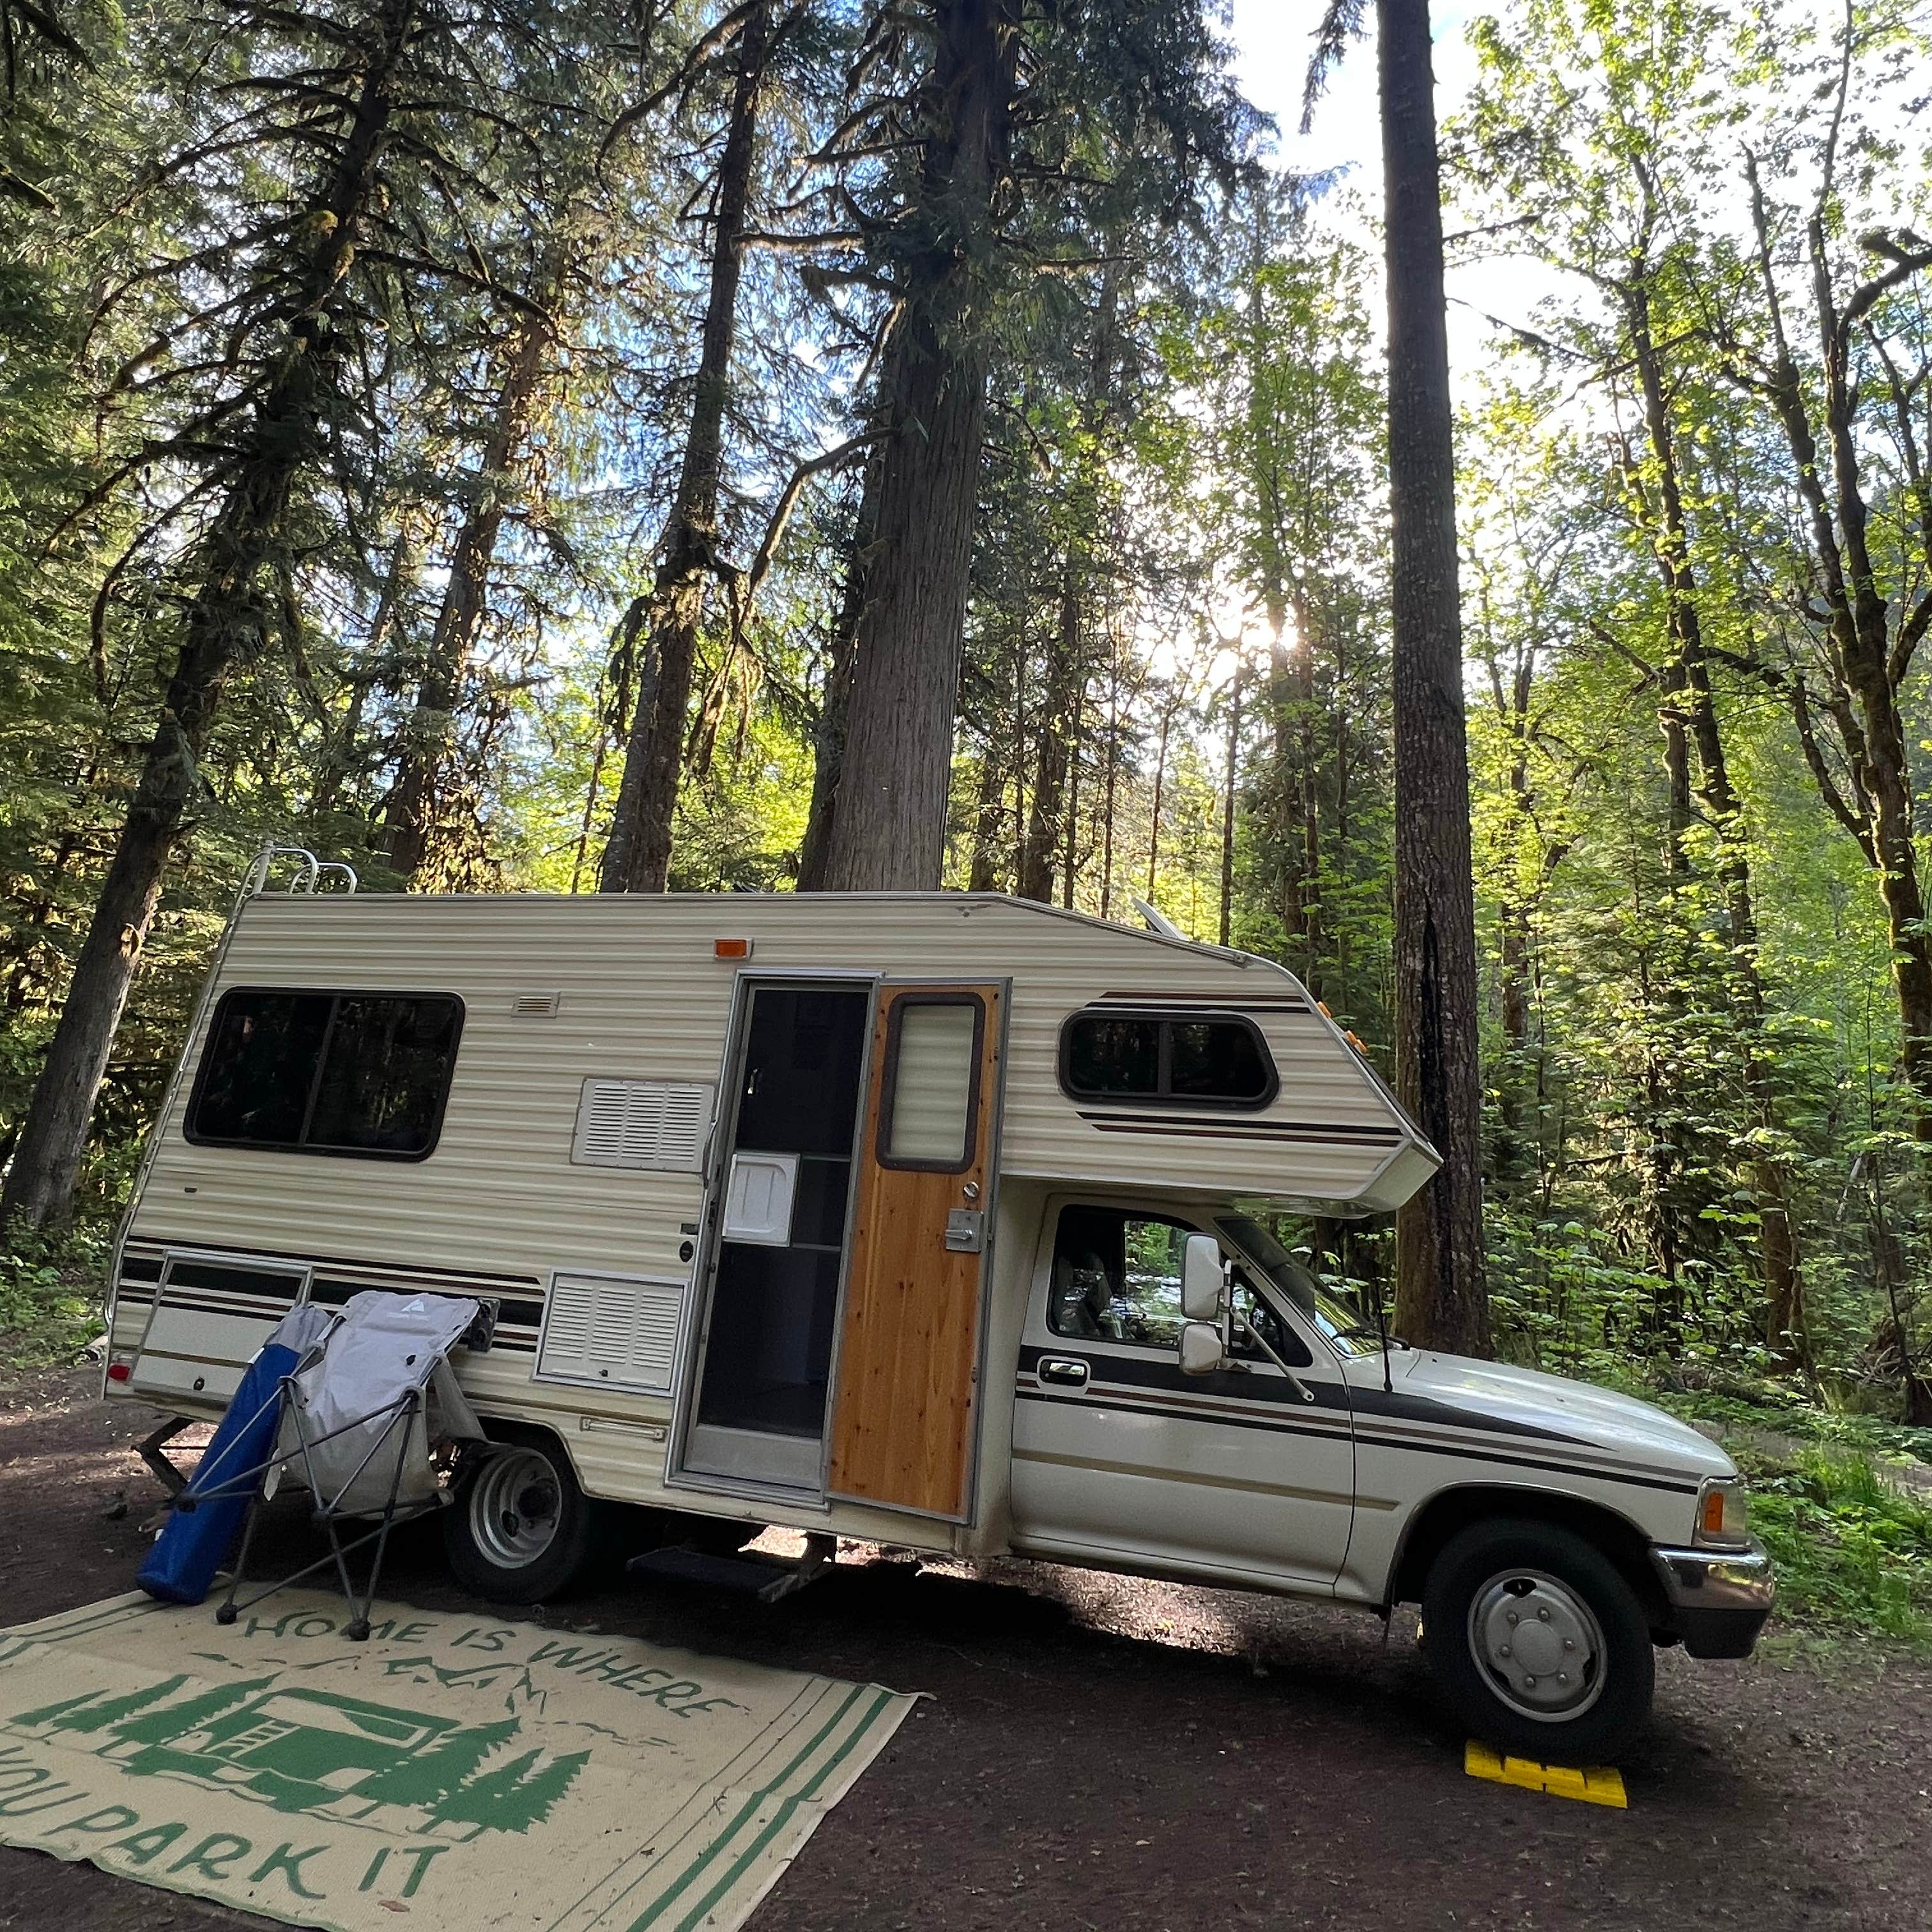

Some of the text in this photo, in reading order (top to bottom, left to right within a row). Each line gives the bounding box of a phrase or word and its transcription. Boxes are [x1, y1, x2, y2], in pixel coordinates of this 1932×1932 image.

[450, 1628, 516, 1652] IS
[526, 1641, 751, 1718] WHERE
[38, 1805, 331, 1900] PARK
[358, 1845, 450, 1898] IT
